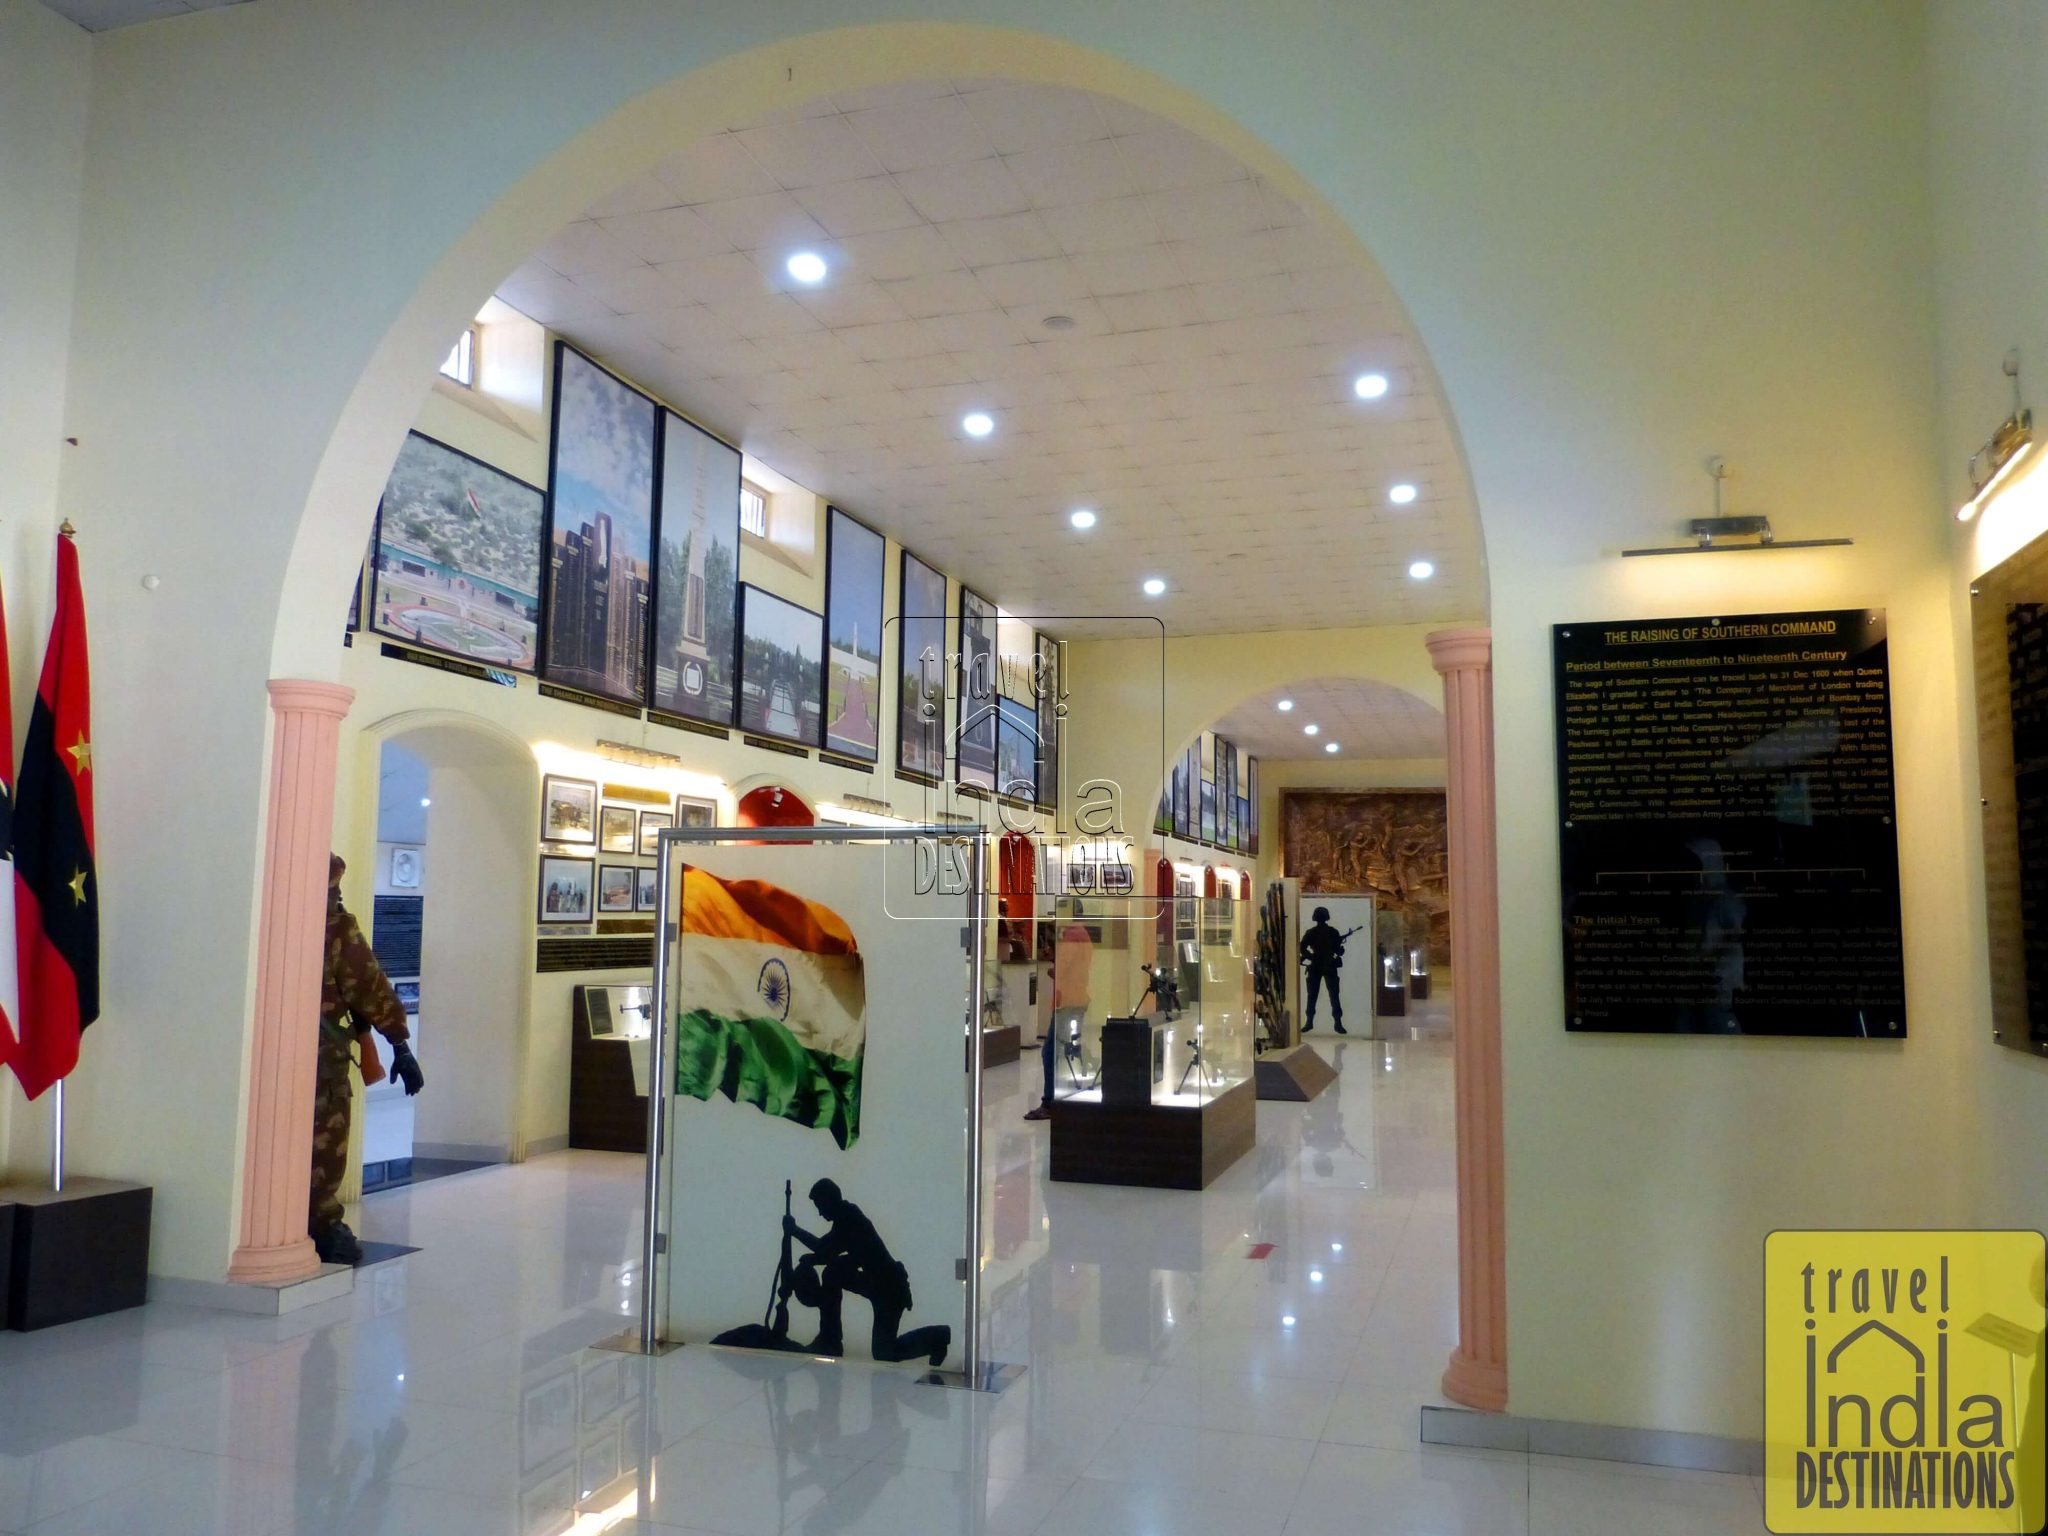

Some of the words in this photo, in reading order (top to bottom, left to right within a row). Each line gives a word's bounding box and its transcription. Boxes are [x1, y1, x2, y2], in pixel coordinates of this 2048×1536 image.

[1605, 630, 1627, 643] THE
[1631, 628, 1679, 642] RAISING
[1682, 627, 1698, 639] OF
[1701, 623, 1768, 638] SOUTHERN
[1771, 620, 1836, 635] COMMAND
[1565, 660, 1600, 671] Period
[1603, 658, 1649, 669] between
[1652, 655, 1720, 667] Seventeenth
[1723, 654, 1734, 664] to
[1737, 652, 1798, 663] Nineteenth
[1801, 649, 1847, 662] Century
[1616, 677, 1649, 686] Southern
[1652, 676, 1690, 684] Command
[1832, 668, 1853, 676] when
[1856, 667, 1882, 676] Queen
[1565, 692, 1598, 700] Elizabeth
[1609, 690, 1637, 699] granted
[1716, 685, 1751, 695] Company
[1821, 681, 1850, 690] London
[1855, 680, 1883, 690] trading
[1696, 698, 1731, 708] Company
[1829, 694, 1860, 703] Bombay
[1566, 716, 1596, 725] Portugal
[1717, 710, 1767, 720] Headquarters
[1803, 707, 1834, 716] Bombay
[1583, 727, 1609, 736] turning
[1612, 727, 1630, 735] point
[1568, 764, 1611, 773] government
[1670, 773, 1710, 782] Presidency
[1714, 773, 1734, 781] Army
[1568, 789, 1588, 797] Army
[1702, 810, 1722, 819] Army
[1574, 916, 1593, 924] The
[1596, 916, 1626, 924] Initial
[1630, 916, 1660, 924] Years
